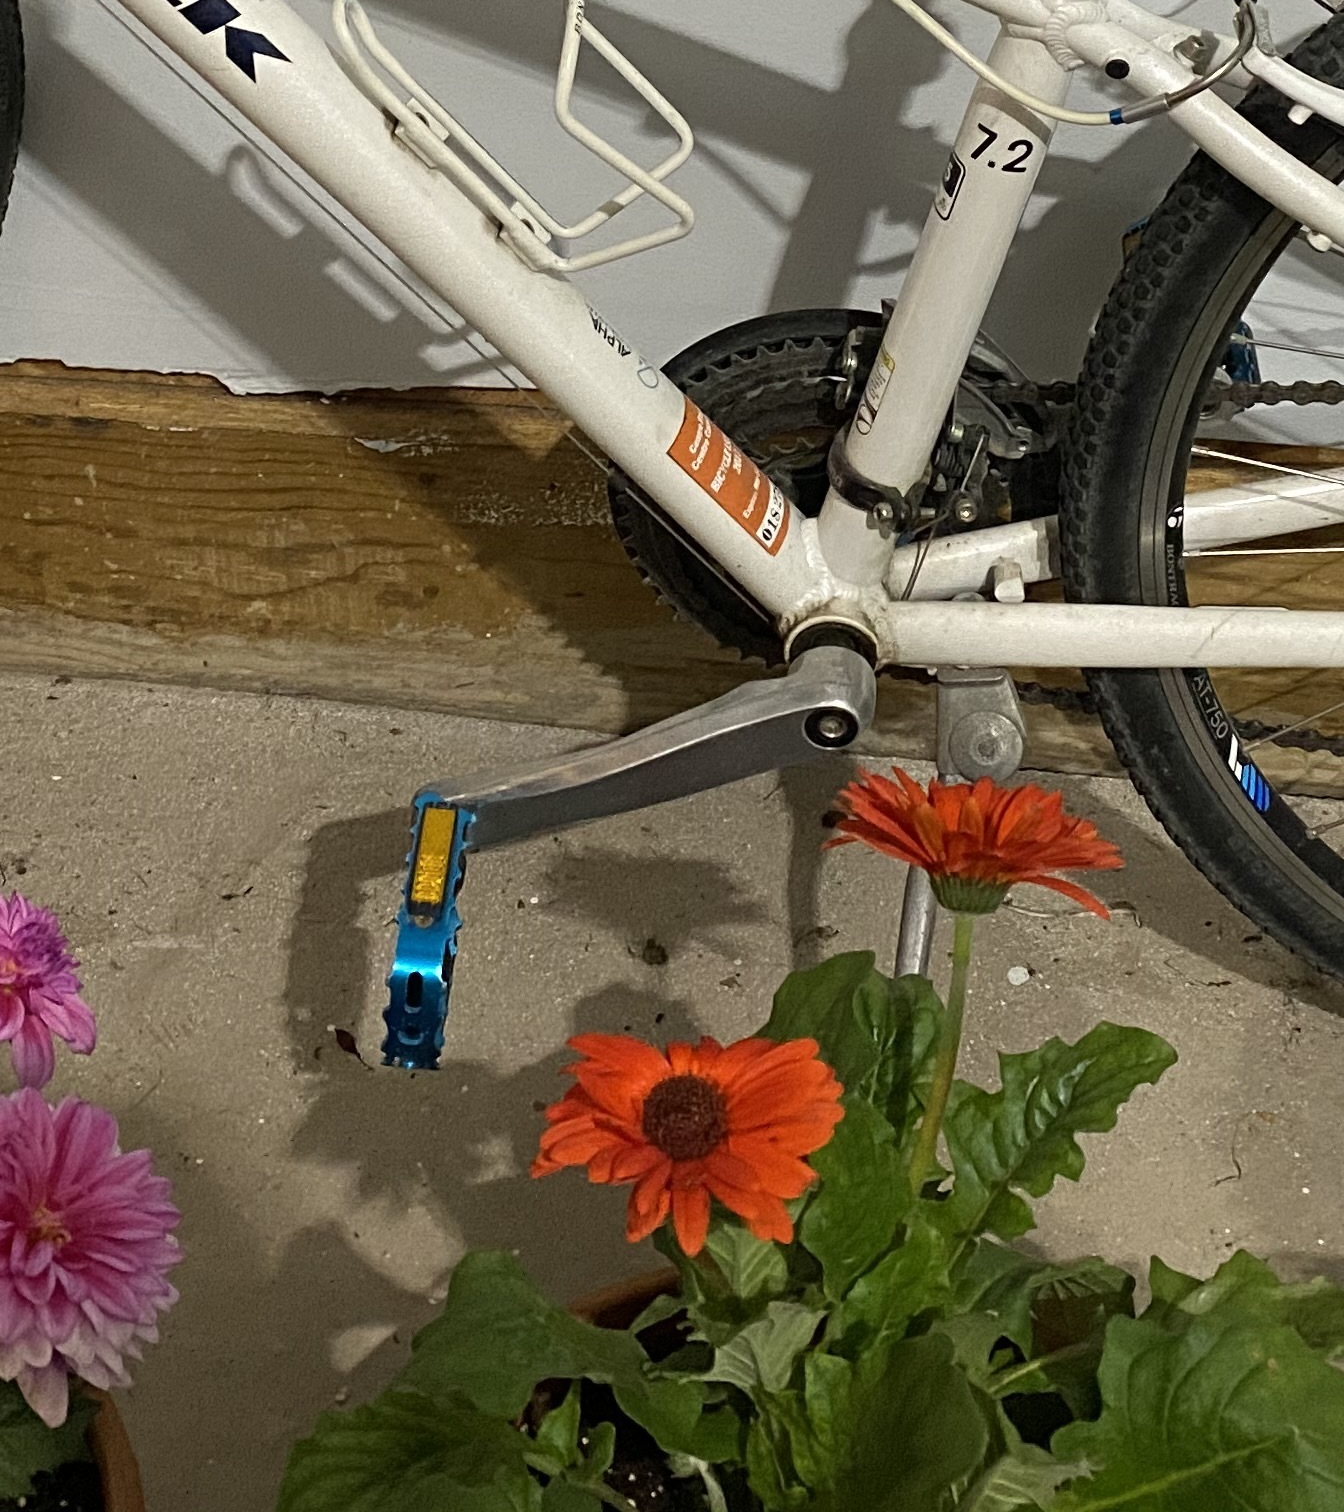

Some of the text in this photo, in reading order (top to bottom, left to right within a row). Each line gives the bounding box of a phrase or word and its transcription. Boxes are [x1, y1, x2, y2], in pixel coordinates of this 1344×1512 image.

[970, 122, 1034, 173] 7.2
[588, 310, 632, 358] ALPHA
[1193, 673, 1230, 740] AT-750
